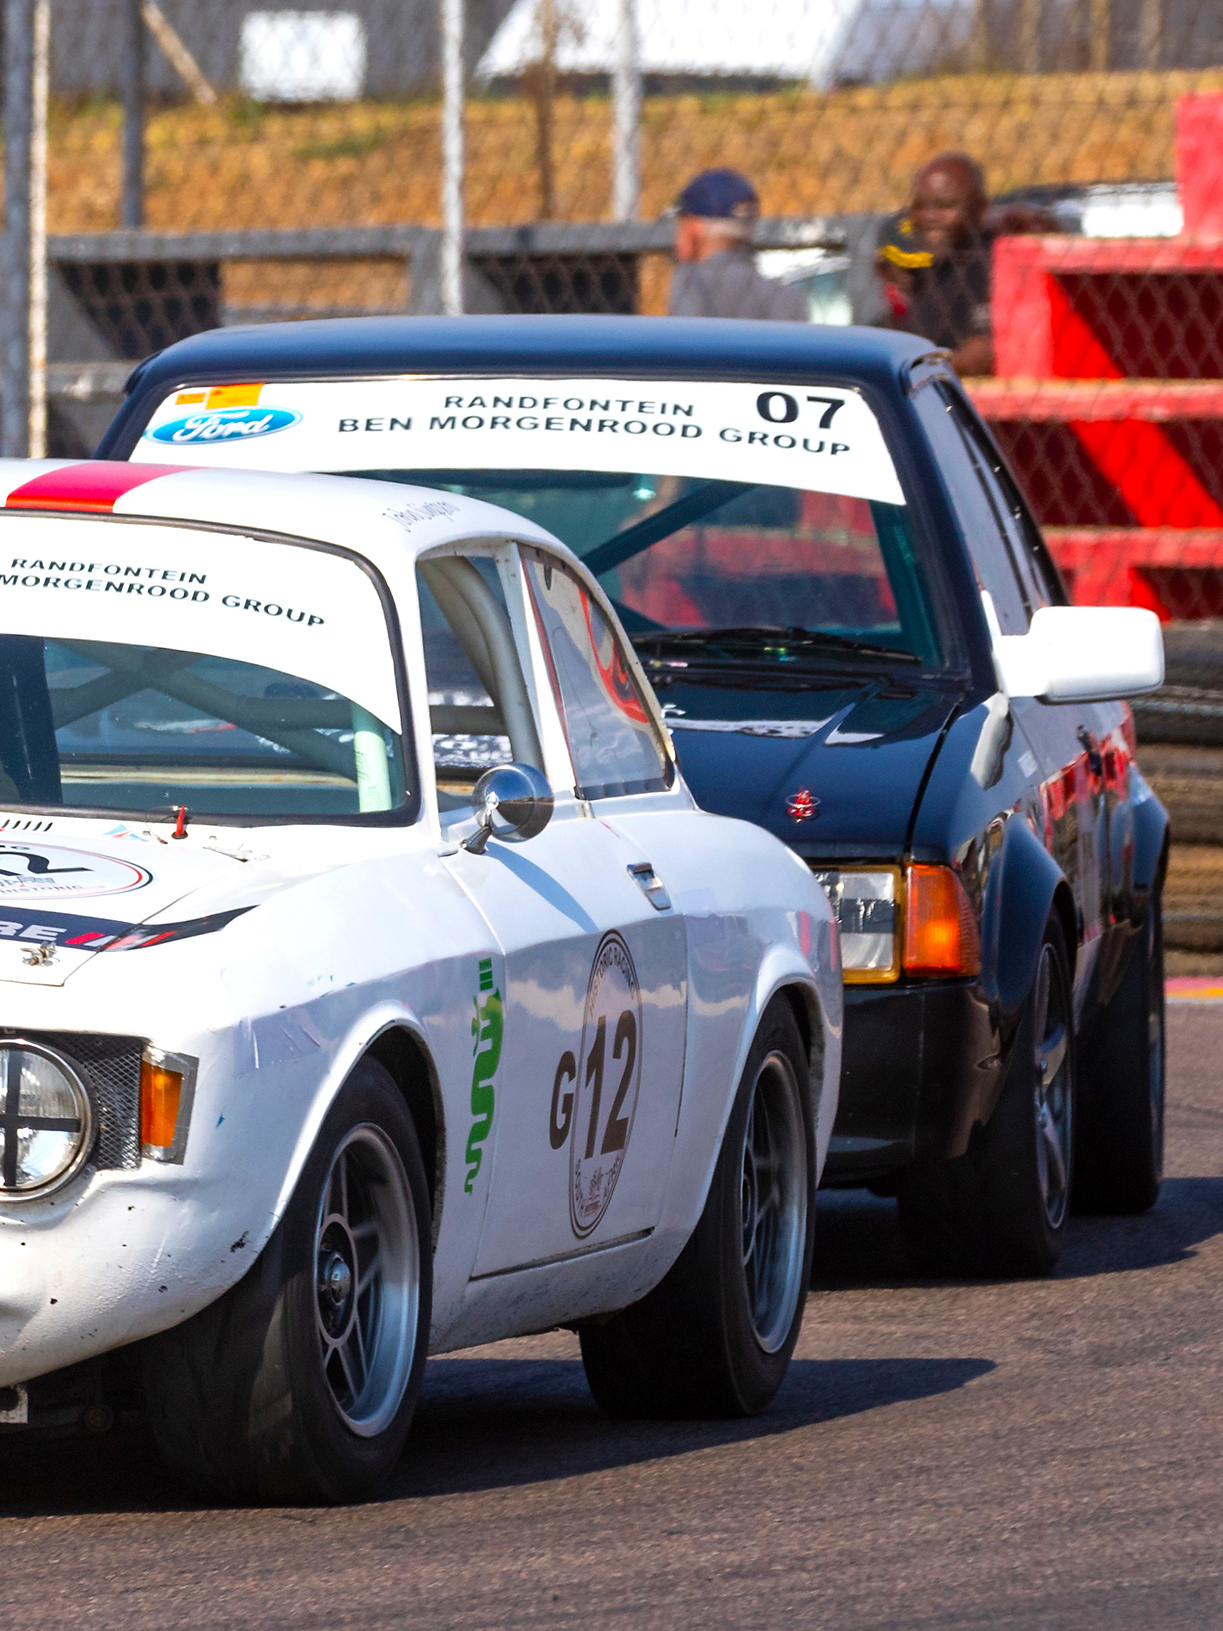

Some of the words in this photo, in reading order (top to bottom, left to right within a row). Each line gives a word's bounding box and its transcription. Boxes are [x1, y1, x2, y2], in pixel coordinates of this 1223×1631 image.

[444, 395, 694, 417] RANDFONTEIN
[756, 391, 847, 430] 07
[173, 410, 274, 442] Ford
[338, 418, 413, 433] BEN
[428, 415, 704, 440] MORGENROOD
[719, 427, 851, 456] GROUP
[11, 557, 208, 584] RANDFONTEIN
[221, 595, 326, 627] GROUP
